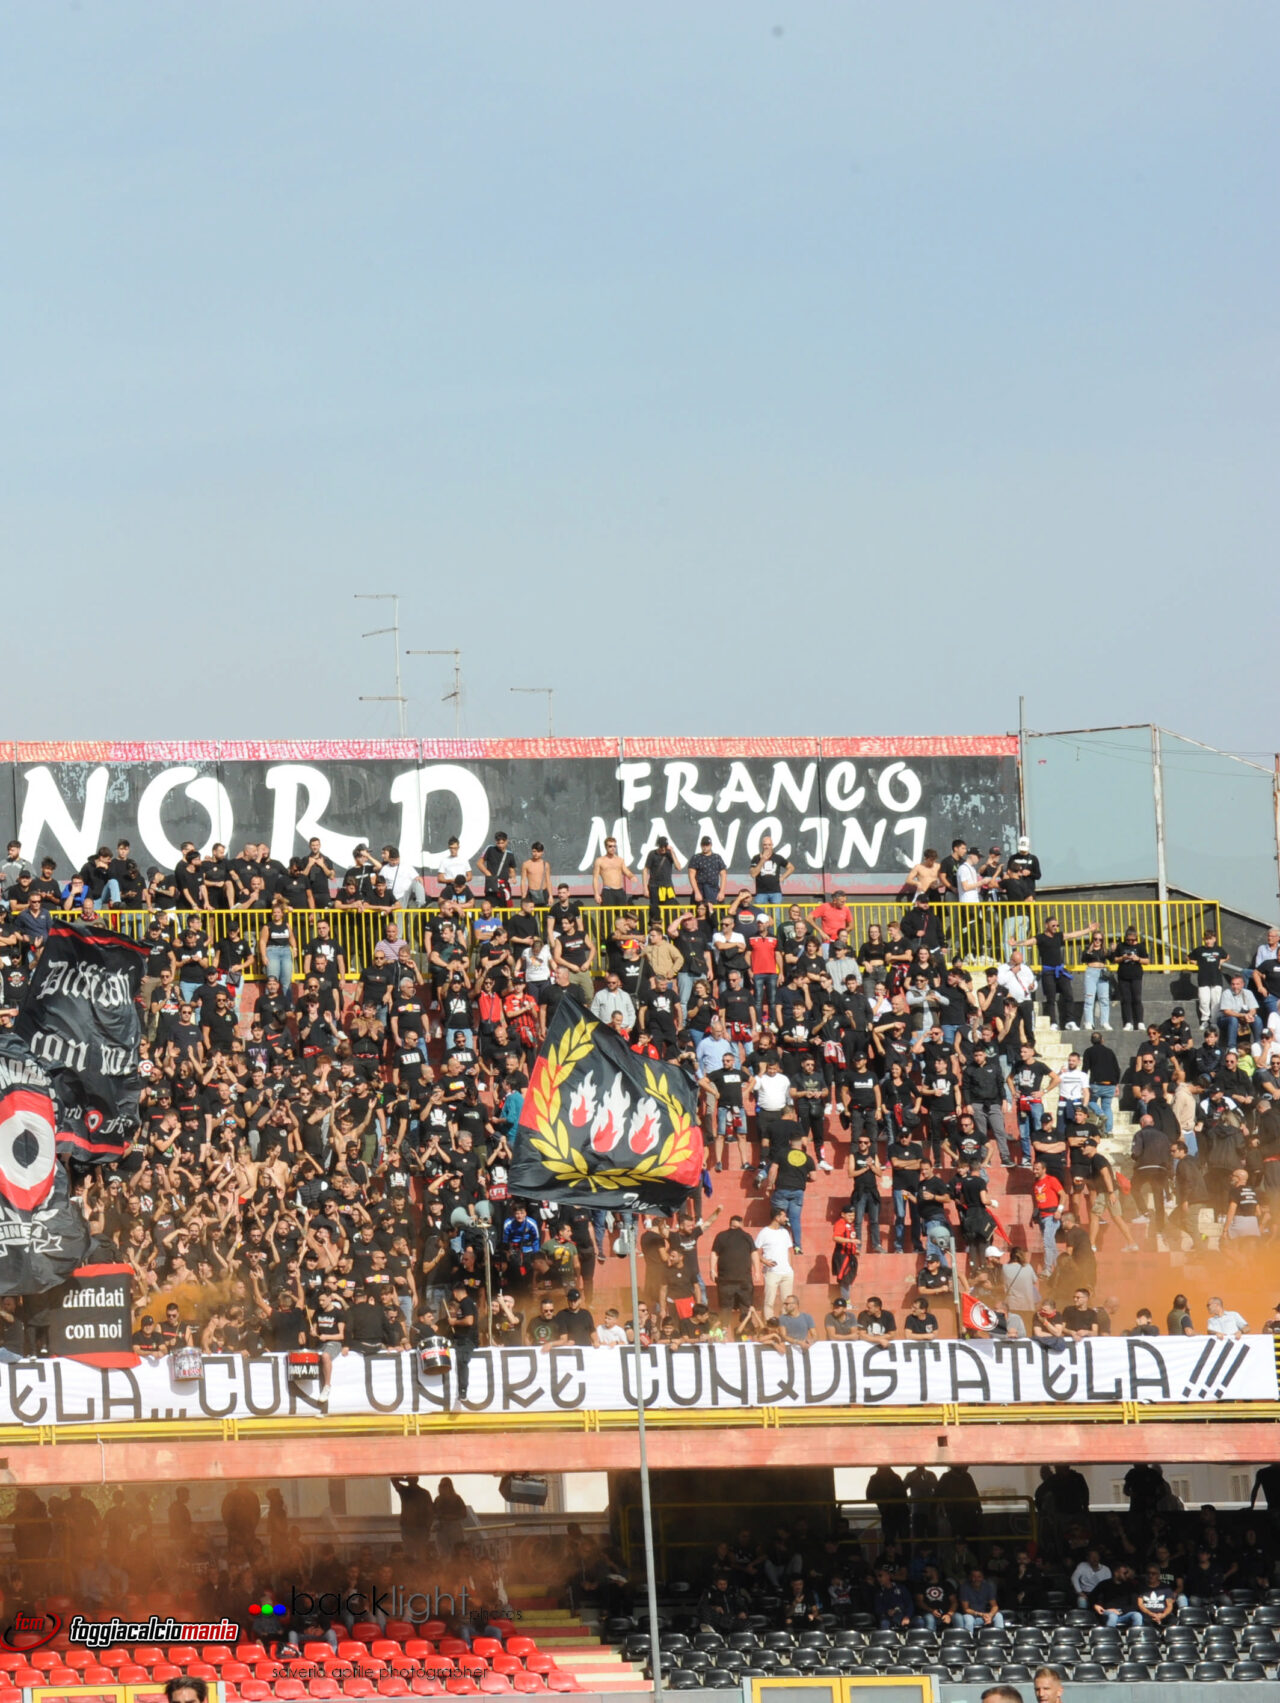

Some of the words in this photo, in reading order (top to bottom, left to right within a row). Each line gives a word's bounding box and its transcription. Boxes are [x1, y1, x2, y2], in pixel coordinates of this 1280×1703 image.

[616, 761, 921, 812] FRANCO
[20, 764, 489, 872] NORD
[63, 1287, 125, 1308] diffidati
[65, 1324, 95, 1339] con
[99, 1319, 122, 1338] noi
